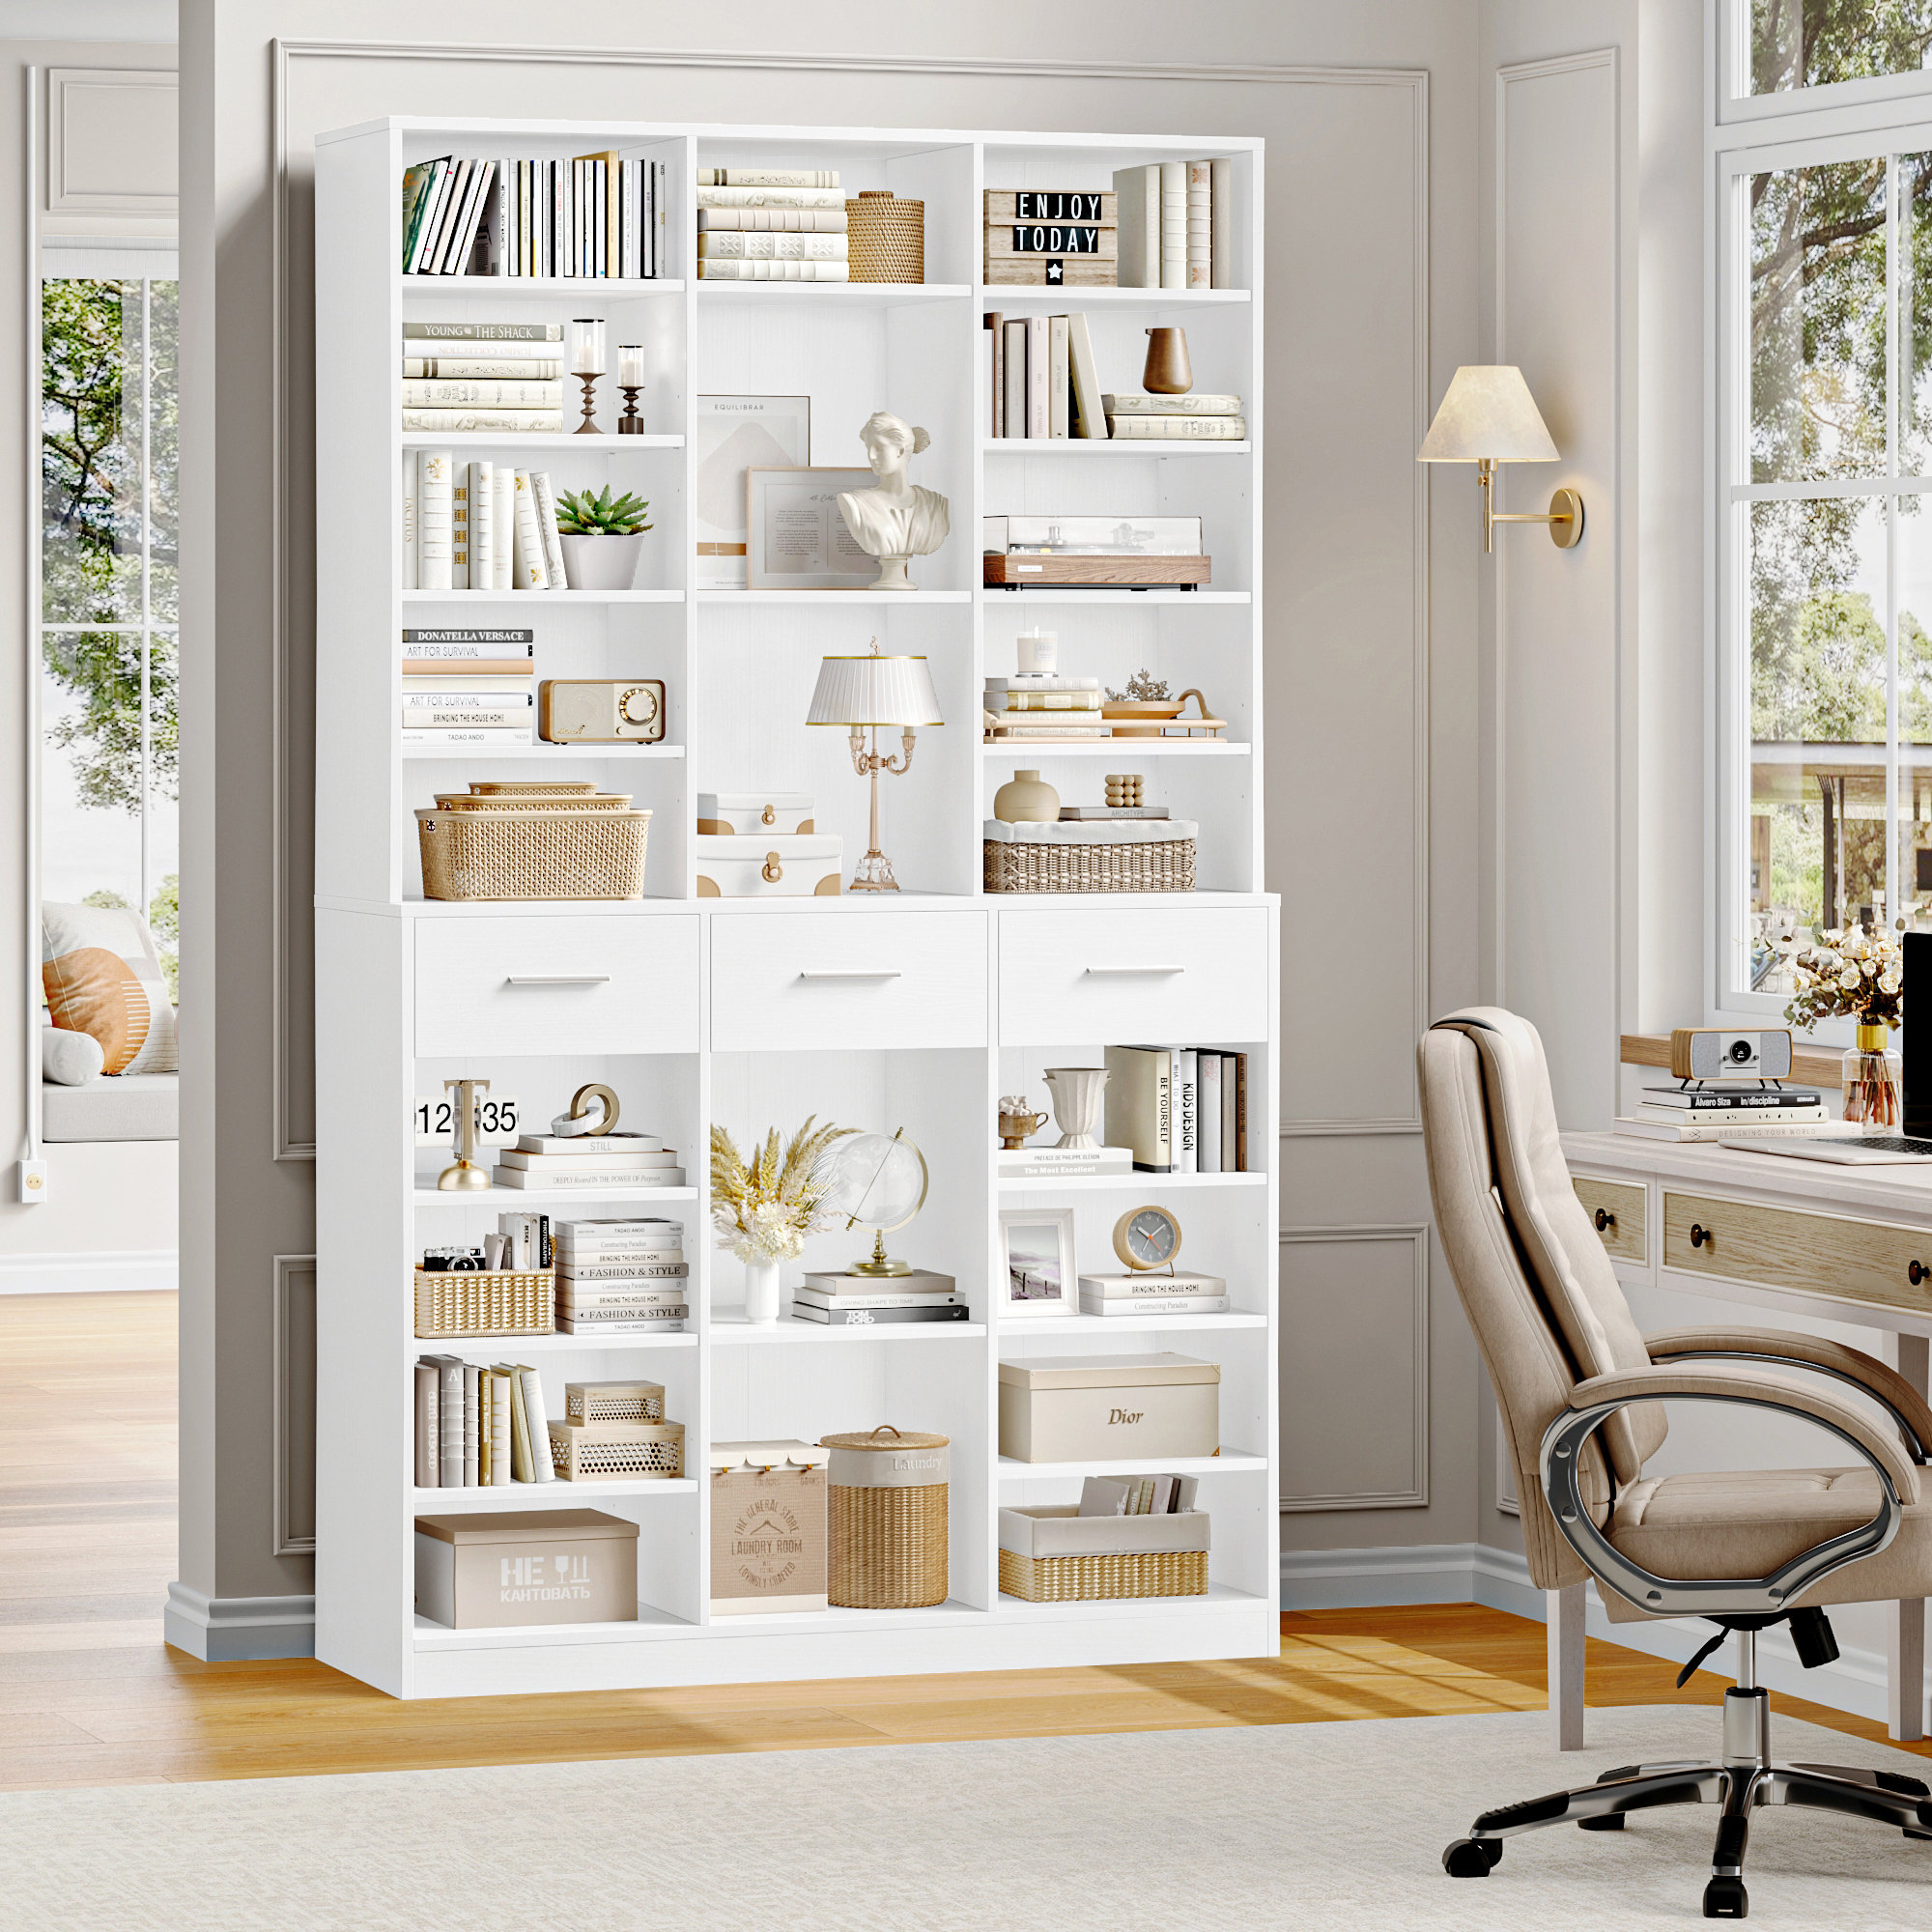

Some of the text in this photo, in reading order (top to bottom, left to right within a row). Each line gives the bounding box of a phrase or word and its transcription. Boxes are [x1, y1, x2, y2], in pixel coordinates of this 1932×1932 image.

[1019, 193, 1099, 220] ENJOY
[1016, 226, 1097, 253] TODAY
[425, 325, 533, 338] YOUNG THE SHACK
[405, 496, 414, 543] TACITUS
[417, 631, 525, 641] DONATELLA VERSACE
[407, 646, 479, 657] ART FOR SURVIVAL
[410, 696, 480, 706] ART FOR SURVIVAL
[433, 714, 504, 723] BRINGING THE HOUSE HOME
[1111, 810, 1146, 818] ARCHITYPE
[1160, 1077, 1168, 1090] BE
[1173, 1088, 1179, 1097] TO
[1695, 1095, 1731, 1107] Álvaro Siza
[1740, 1096, 1780, 1107] in/discipline
[418, 1102, 517, 1134] 12 35
[1182, 1083, 1194, 1151] KIDS DESIGN
[1765, 1128, 1786, 1137] YOUR
[589, 1142, 612, 1151] STILL
[1039, 1166, 1059, 1175] Most
[1061, 1165, 1096, 1175] Excellent
[589, 1265, 681, 1277] FASHION & STYLE
[1131, 1285, 1156, 1293] BRINGING
[1168, 1284, 1184, 1293] HOUSE
[589, 1308, 681, 1320] FASHION & STYLE
[448, 1368, 459, 1382] A
[428, 1391, 438, 1420] art
[1108, 1407, 1144, 1425] Dior
[893, 1455, 944, 1472] Laundry
[734, 1499, 800, 1536] THE GENERAL STORE
[731, 1539, 803, 1556] LAUNDRY ROOM
[500, 1556, 544, 1586] НЕ
[739, 1564, 766, 1588] LOVINGLY
[500, 1586, 591, 1603] КАНТОВАТЬ
